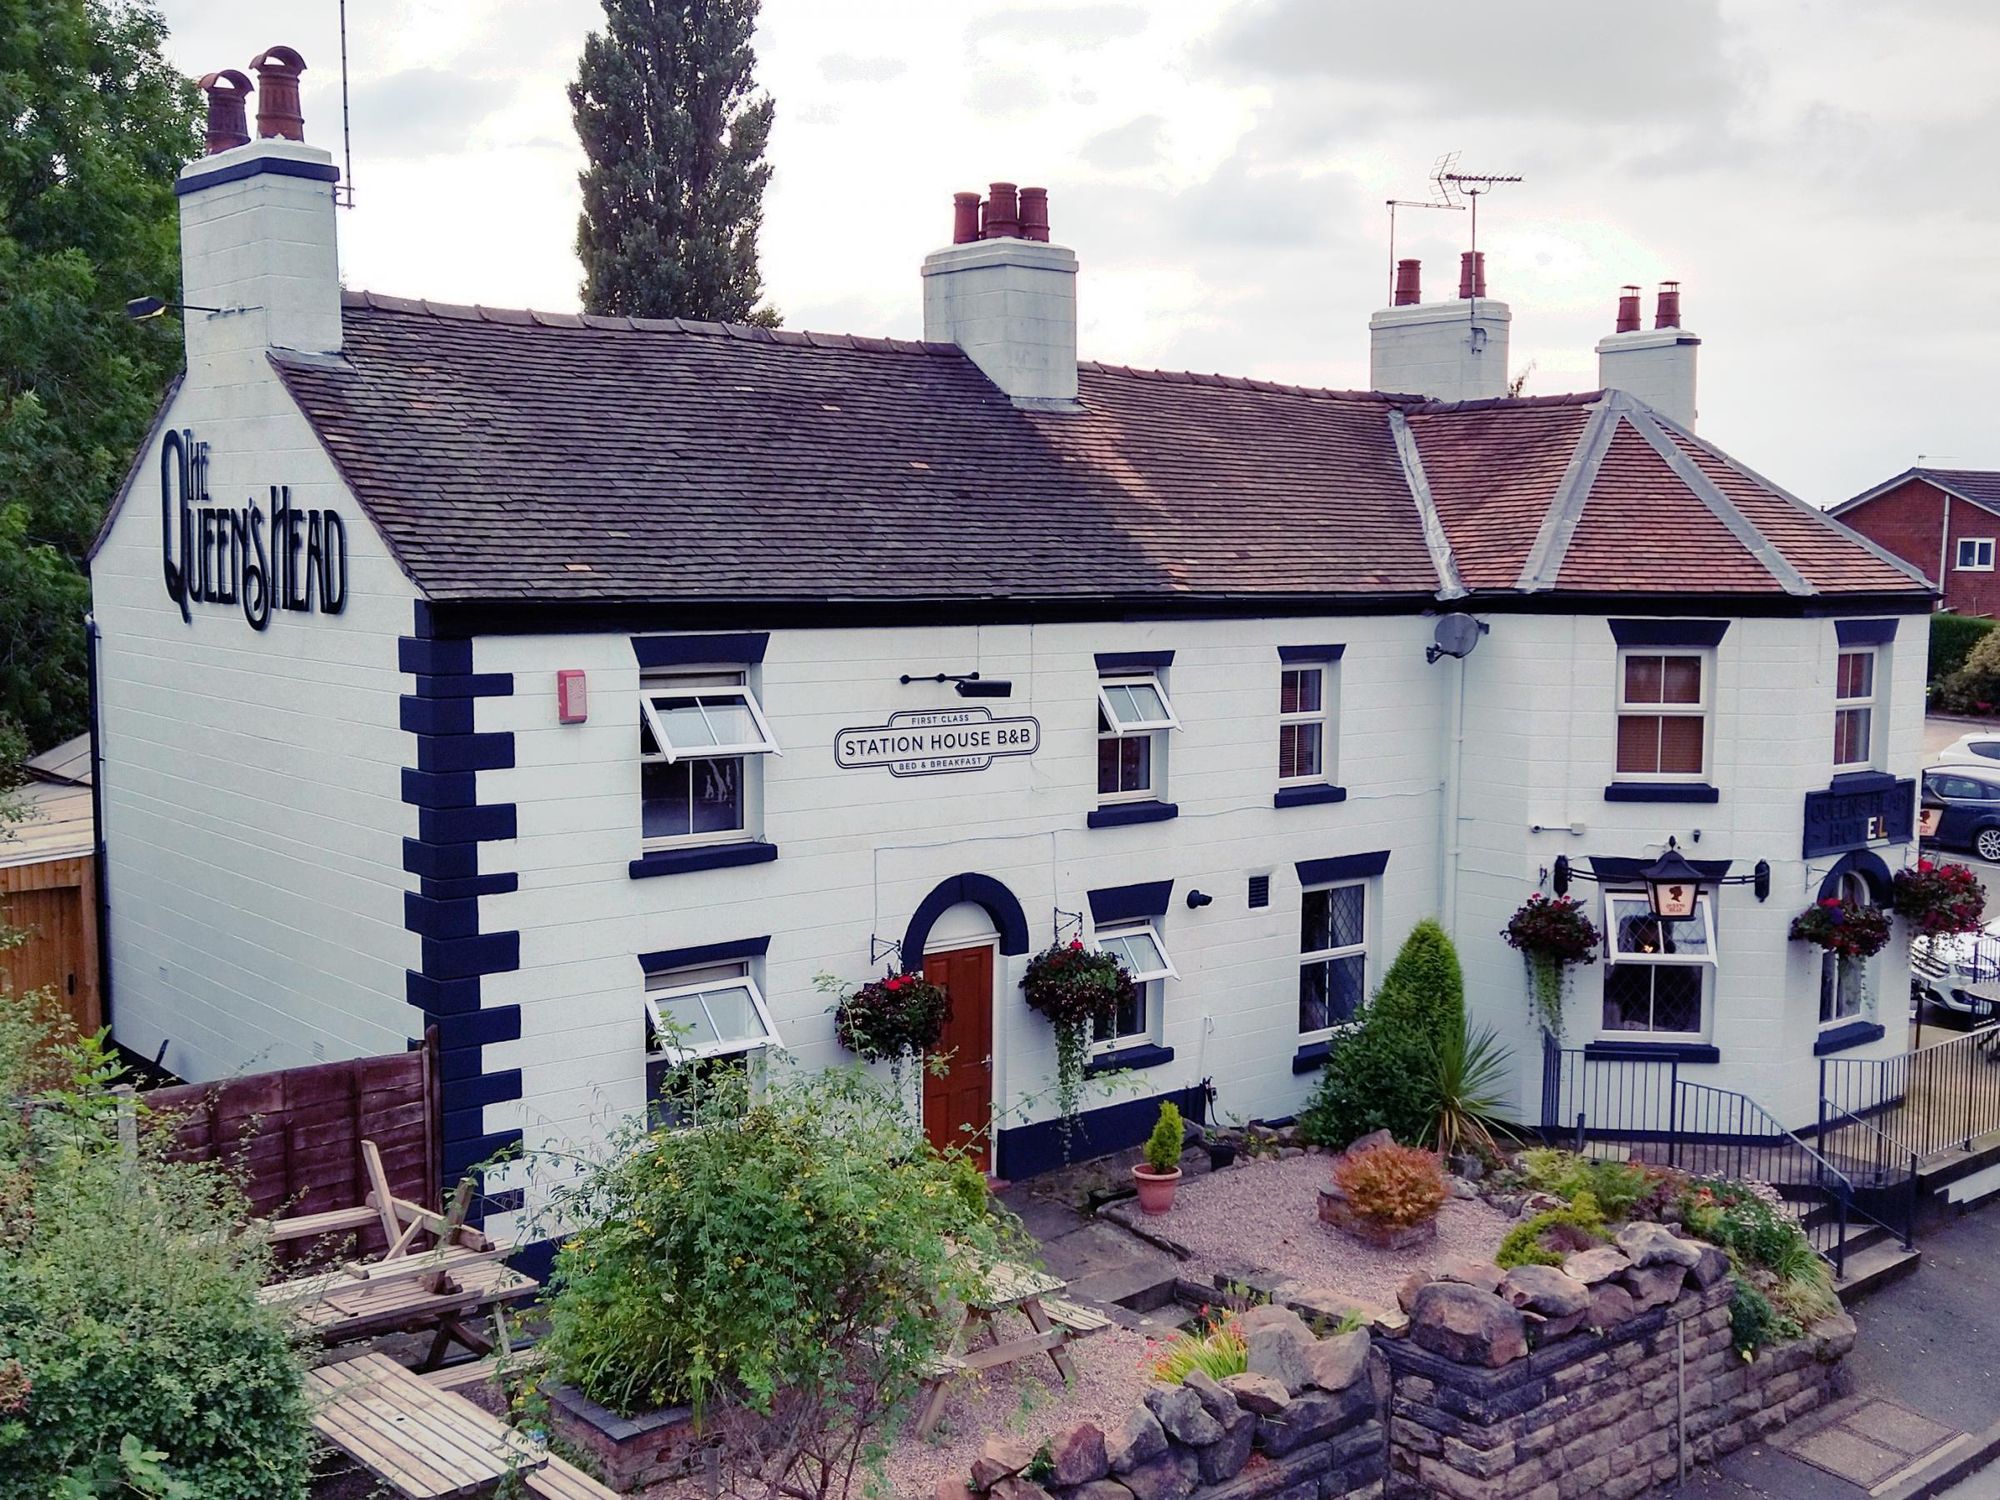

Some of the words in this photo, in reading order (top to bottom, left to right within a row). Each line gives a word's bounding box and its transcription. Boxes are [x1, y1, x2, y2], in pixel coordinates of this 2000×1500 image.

[183, 429, 210, 500] THE
[271, 486, 347, 613] HEAD
[911, 716, 937, 725] FIRST
[941, 714, 970, 723] CLASS
[845, 736, 923, 756] STATION
[931, 731, 990, 750] HOUSE
[997, 728, 1031, 745] B&B
[899, 762, 917, 771] BED
[921, 761, 927, 769] &
[930, 757, 982, 768] BREAKFAST
